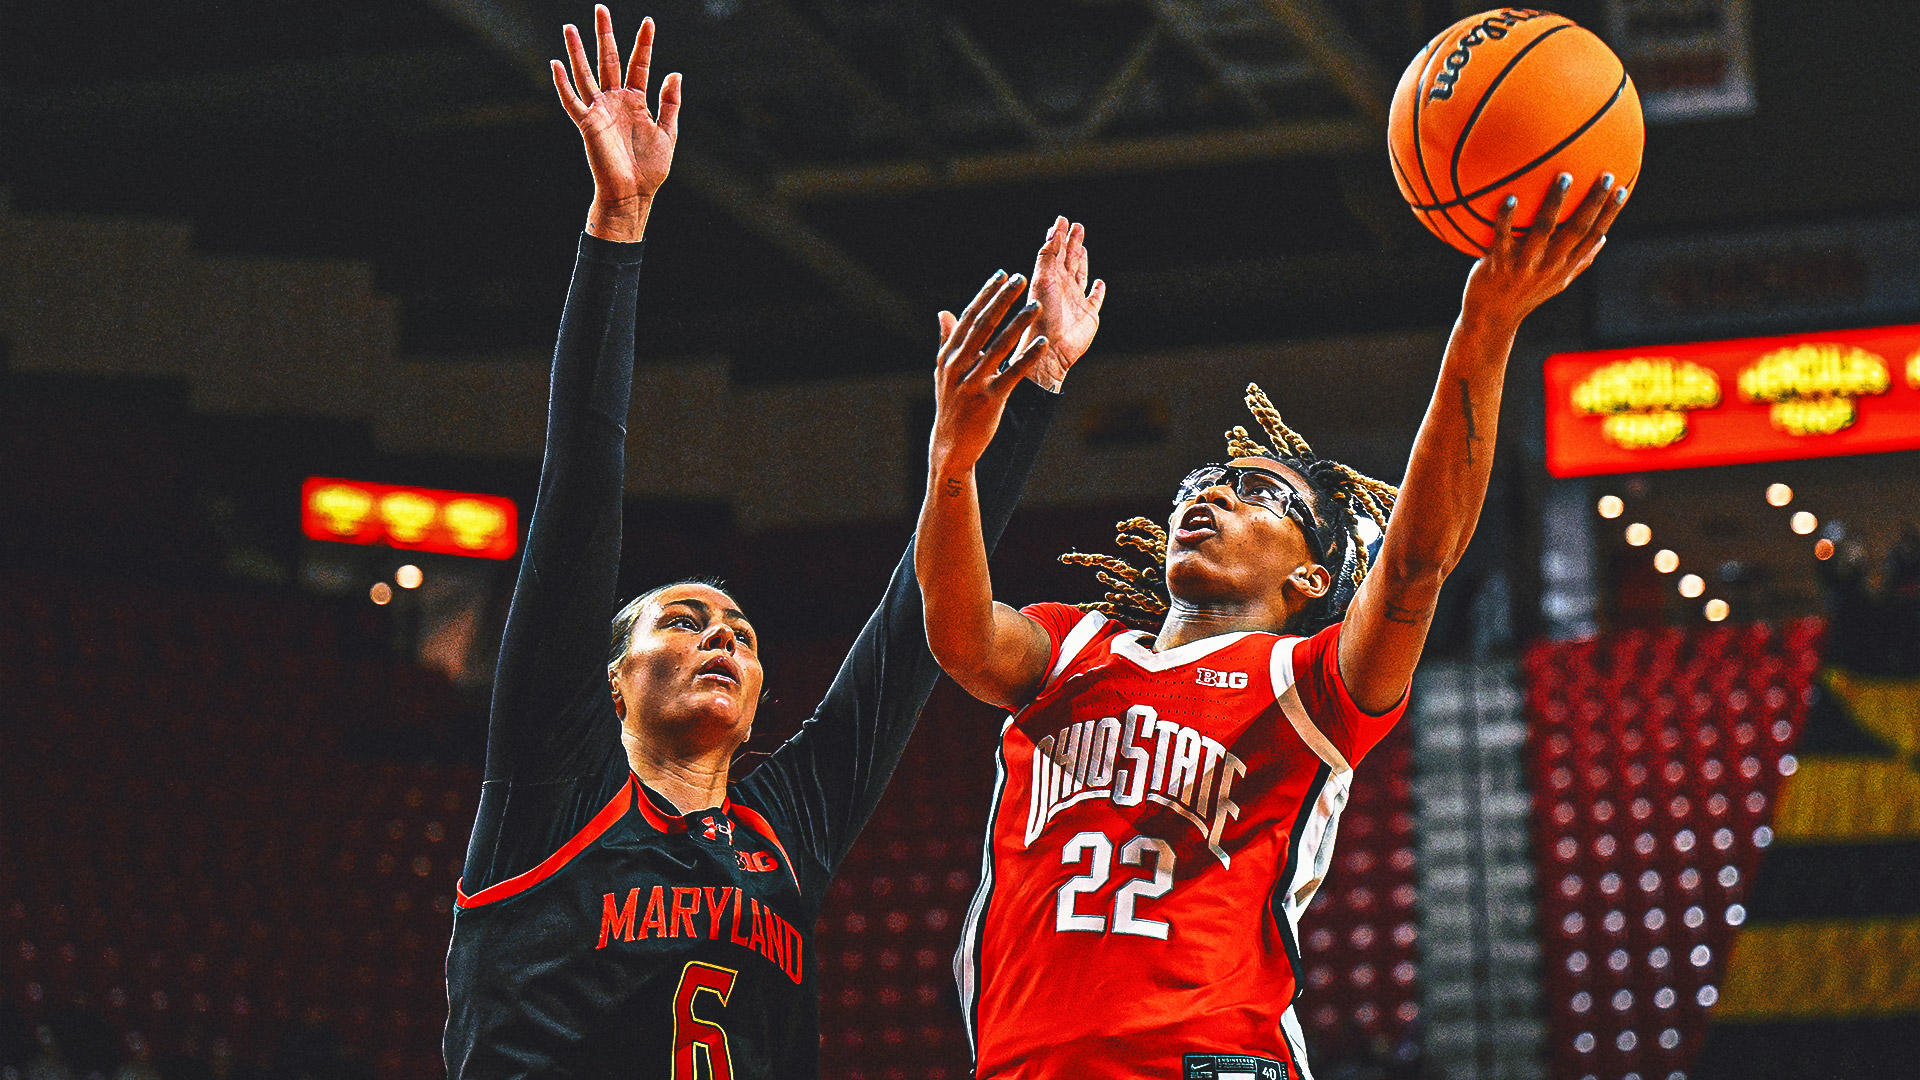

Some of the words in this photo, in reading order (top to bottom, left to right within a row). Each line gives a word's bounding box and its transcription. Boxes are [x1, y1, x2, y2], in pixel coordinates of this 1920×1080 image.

[1024, 716, 1122, 848] OHIO
[1112, 704, 1248, 871] STATE
[595, 885, 803, 985] MARYLAND
[1055, 831, 1177, 940] 22
[671, 960, 738, 1080] 6
[1261, 1066, 1277, 1080] 40
